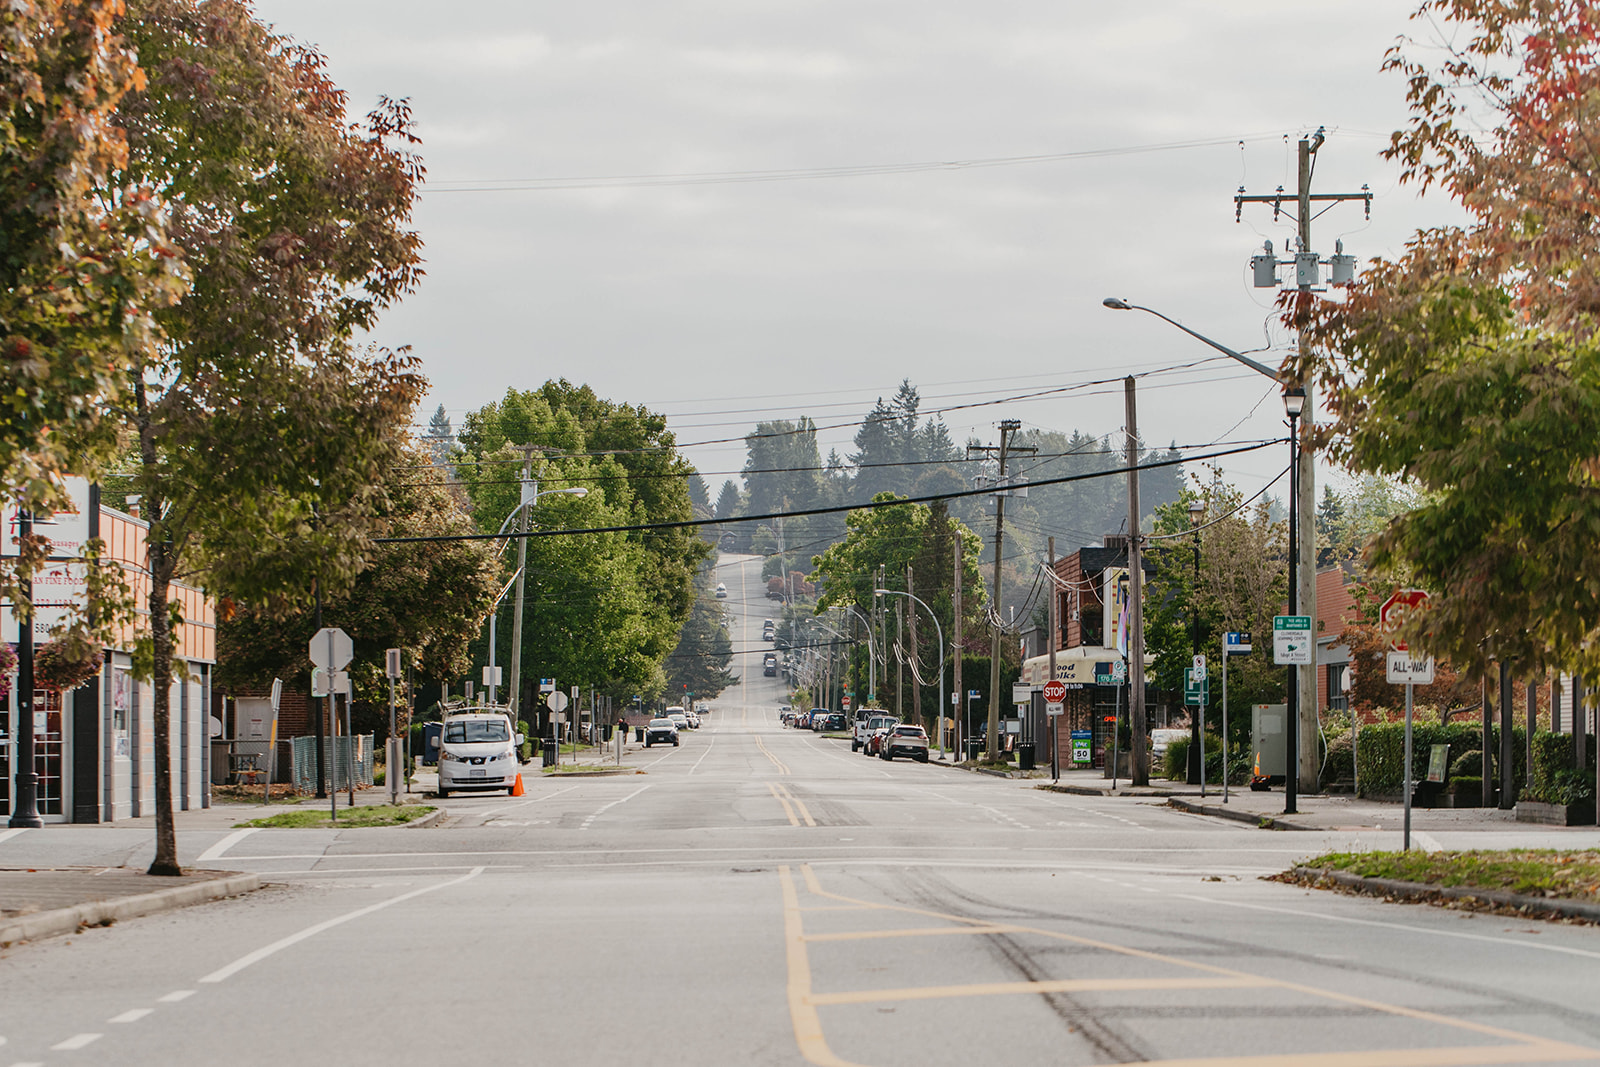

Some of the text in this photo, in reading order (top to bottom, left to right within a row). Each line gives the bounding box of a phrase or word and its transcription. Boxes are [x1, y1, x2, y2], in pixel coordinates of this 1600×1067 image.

[49, 539, 79, 549] ausages
[1057, 663, 1076, 671] ood
[1393, 660, 1428, 673] ALL-WAY
[1056, 671, 1076, 680] olks
[1045, 686, 1065, 697] STOP
[1077, 750, 1088, 758] 50
